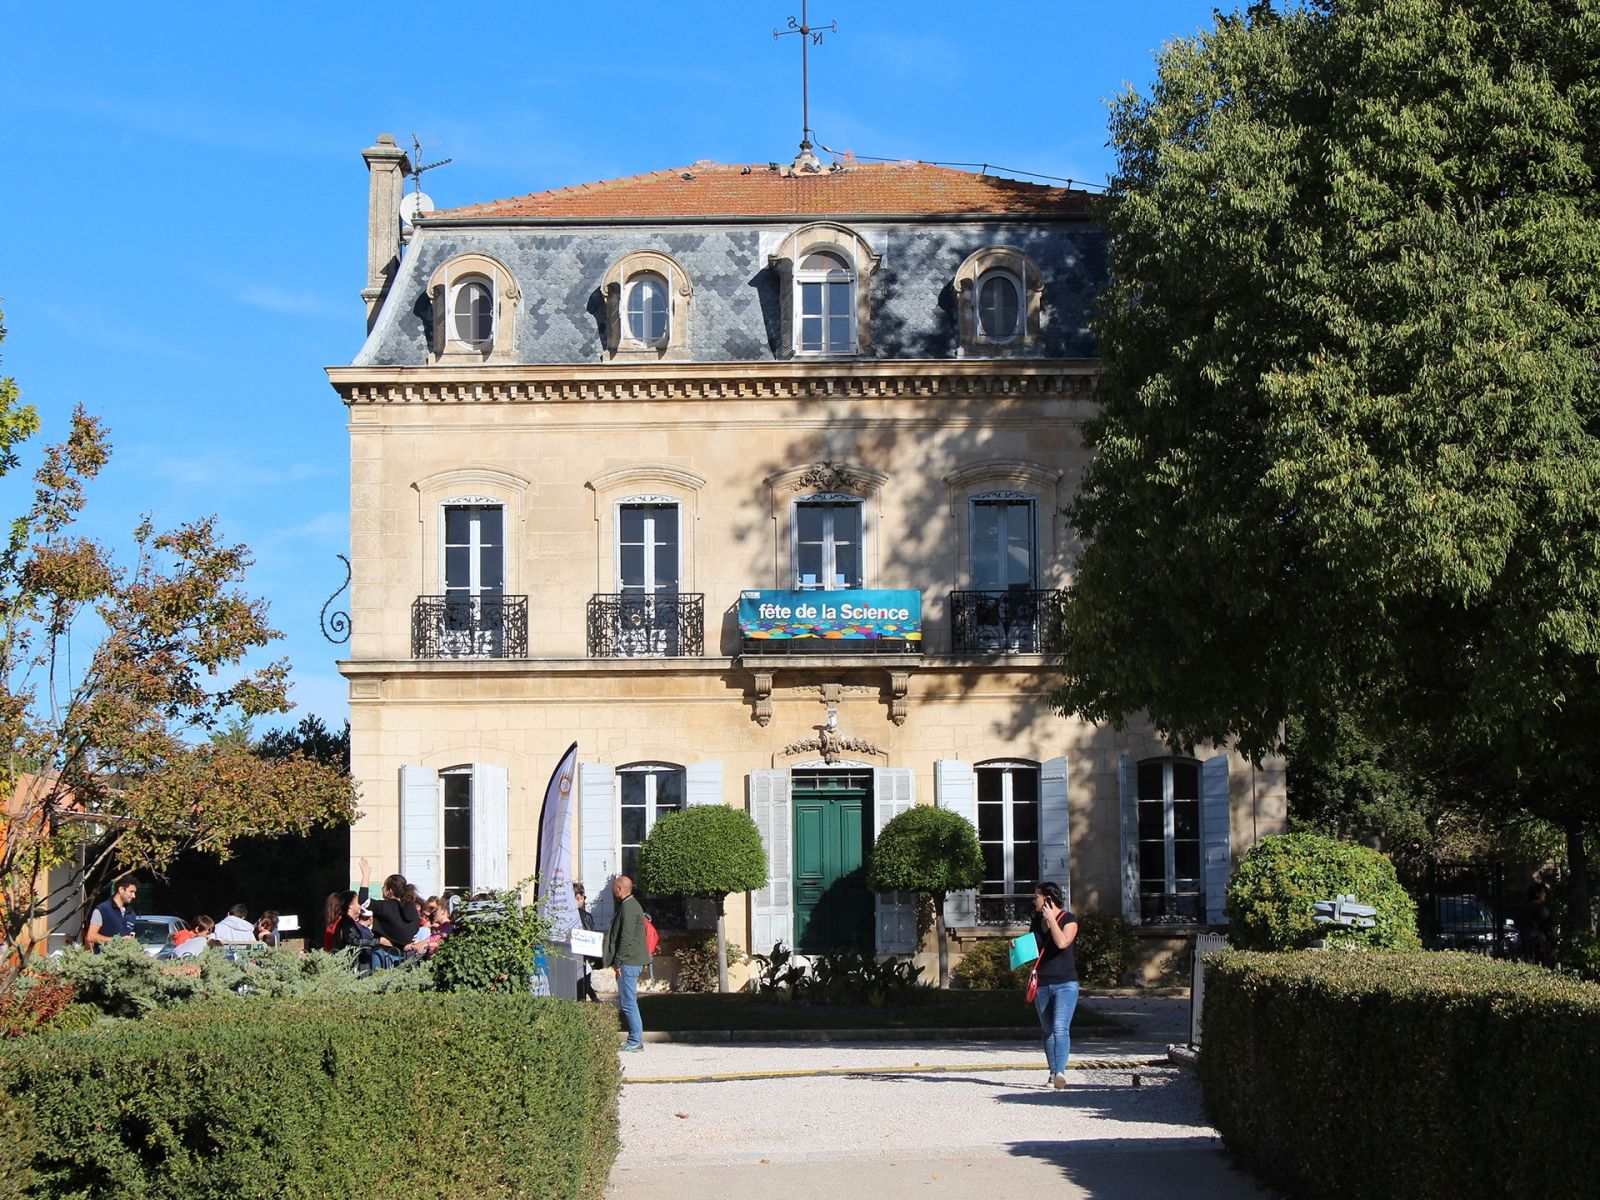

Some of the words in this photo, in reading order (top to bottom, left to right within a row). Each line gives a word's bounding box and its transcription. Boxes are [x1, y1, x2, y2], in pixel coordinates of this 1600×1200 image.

[759, 603, 792, 619] fête
[795, 603, 817, 619] de
[822, 603, 837, 619] la
[840, 603, 909, 620] Science
